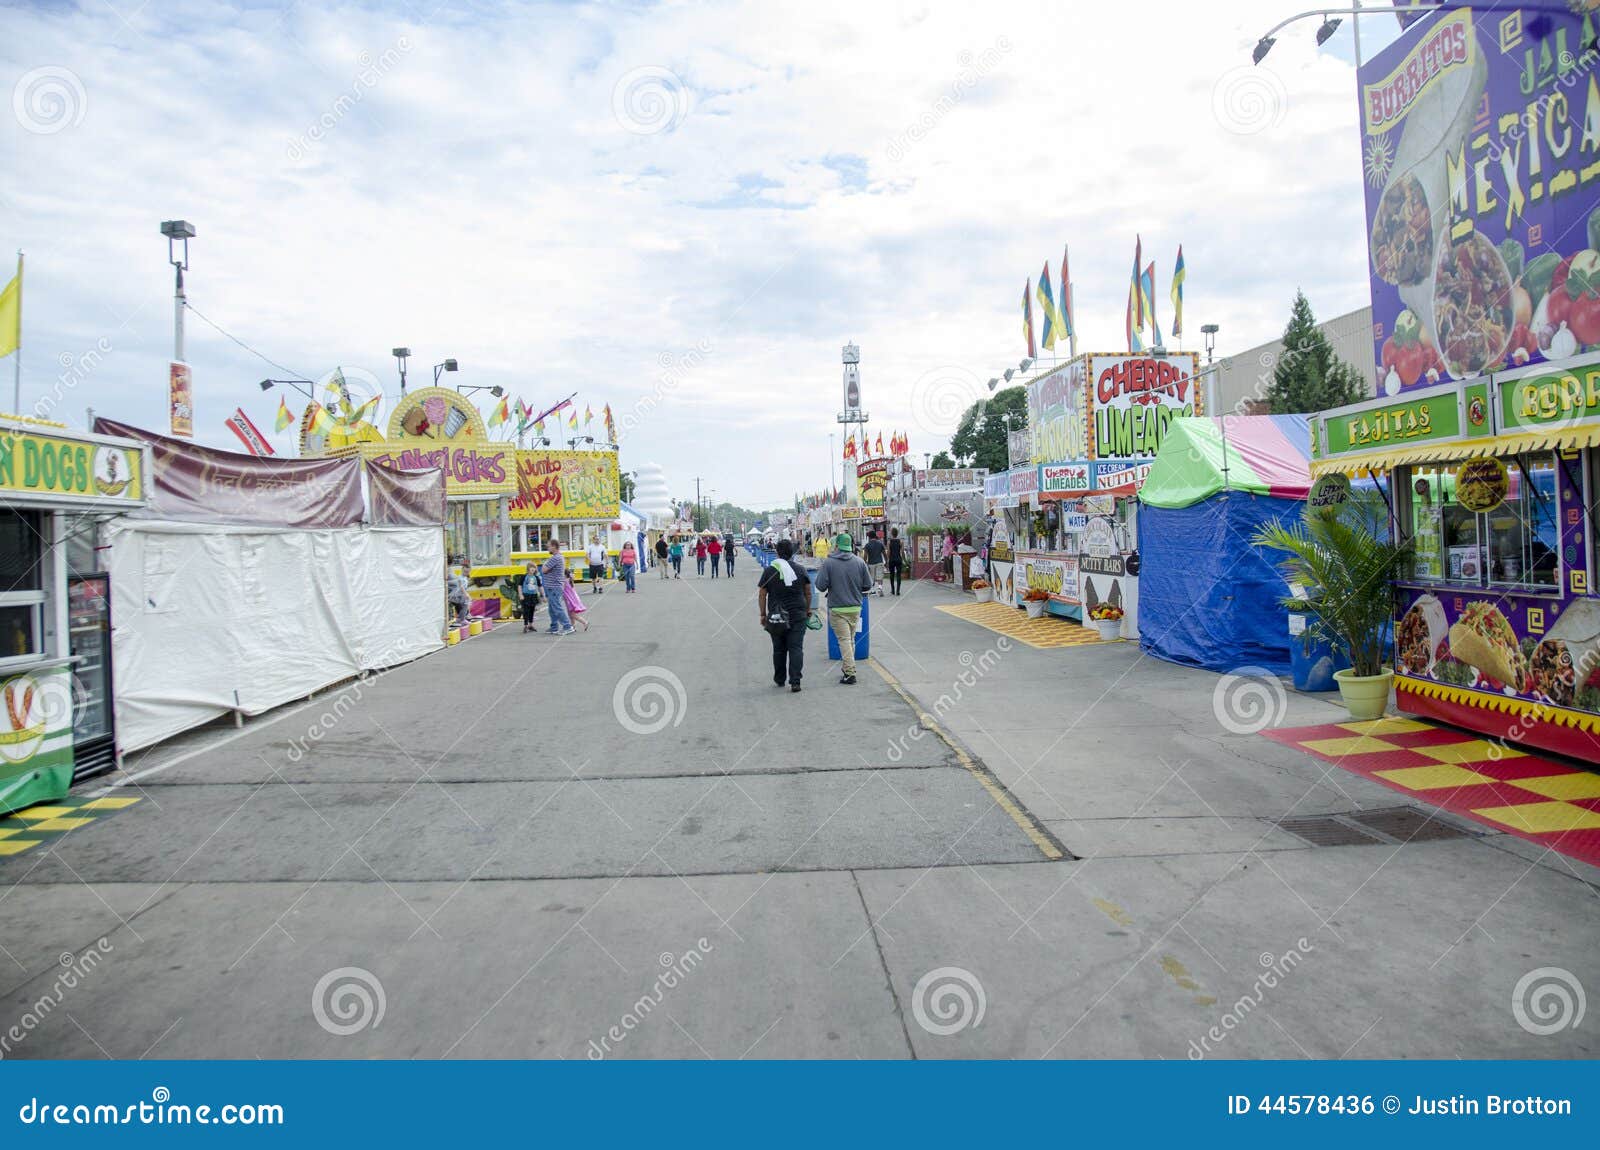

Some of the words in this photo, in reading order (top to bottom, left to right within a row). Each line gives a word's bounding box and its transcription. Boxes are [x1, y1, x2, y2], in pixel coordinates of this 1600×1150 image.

[1369, 21, 1467, 125] BURRITOS
[1097, 359, 1189, 404] CHERRY
[1096, 403, 1193, 458] LIMEAD
[1348, 404, 1431, 444] FAJITAS
[23, 440, 87, 492] DOGS
[1045, 476, 1088, 490] LIMEADES
[1098, 464, 1107, 474] ICE
[1108, 463, 1126, 473] CREAM
[1098, 470, 1137, 488] NUTTY
[530, 476, 561, 509] DOGS
[1081, 557, 1103, 571] NUTTY
[1104, 558, 1122, 573] BARS
